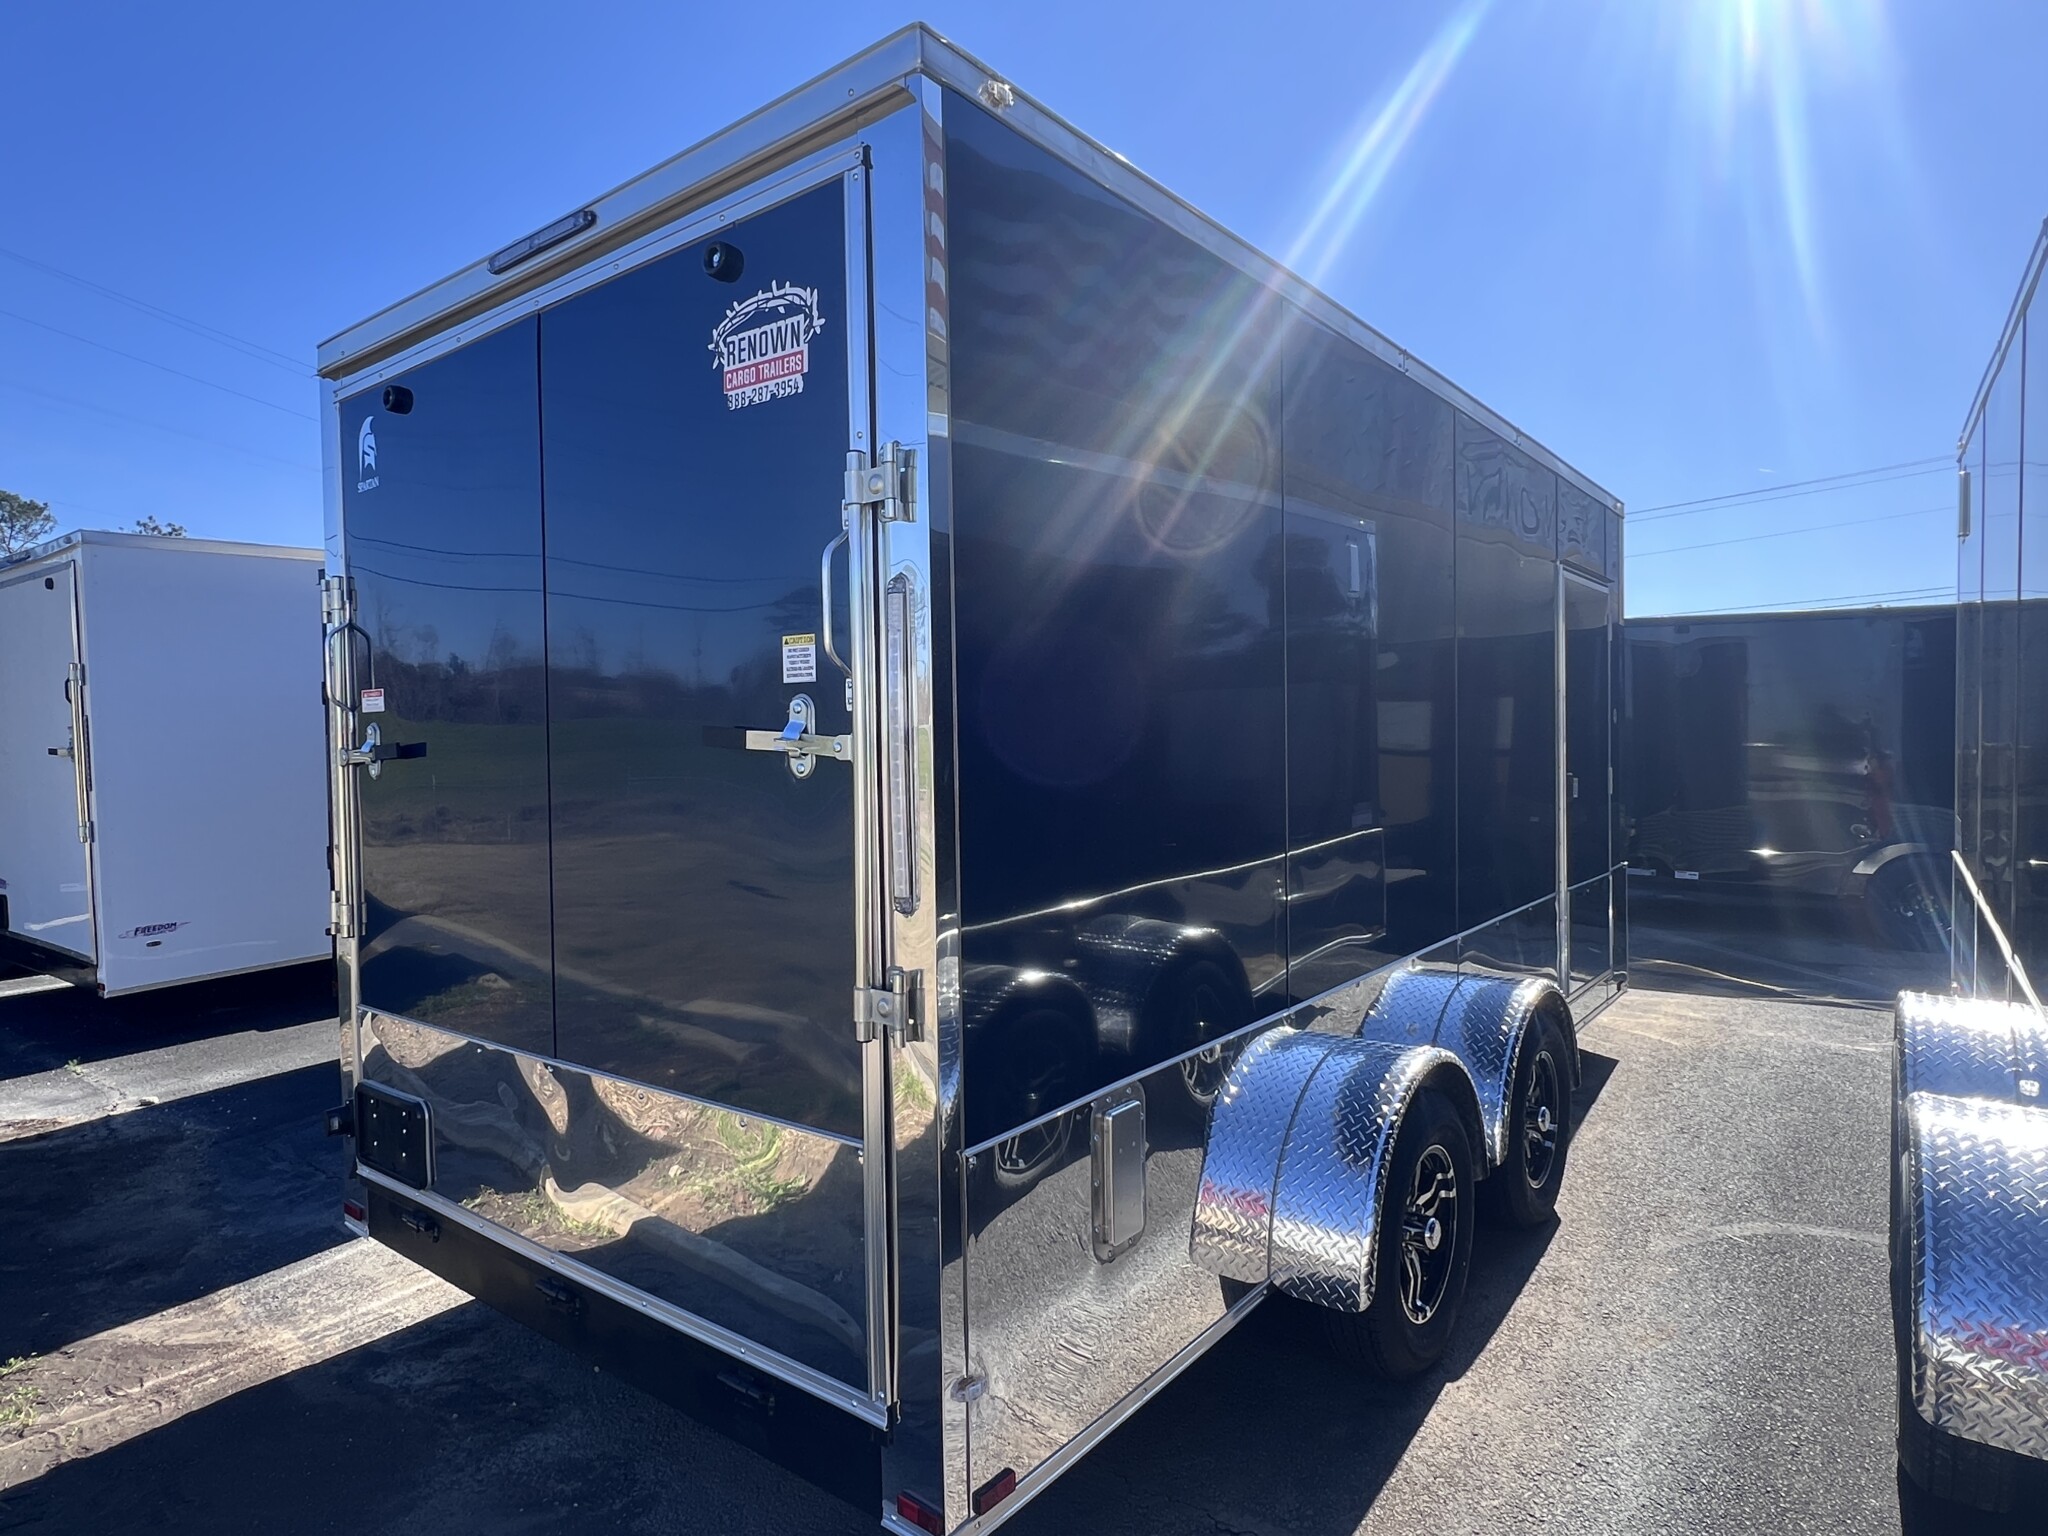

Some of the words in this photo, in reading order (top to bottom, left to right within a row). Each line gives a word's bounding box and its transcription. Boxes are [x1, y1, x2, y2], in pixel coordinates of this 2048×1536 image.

[727, 319, 801, 367] RENOWN
[726, 367, 756, 389] CARGO
[758, 354, 802, 380] TRAILERS
[134, 922, 177, 936] FREEDOM
